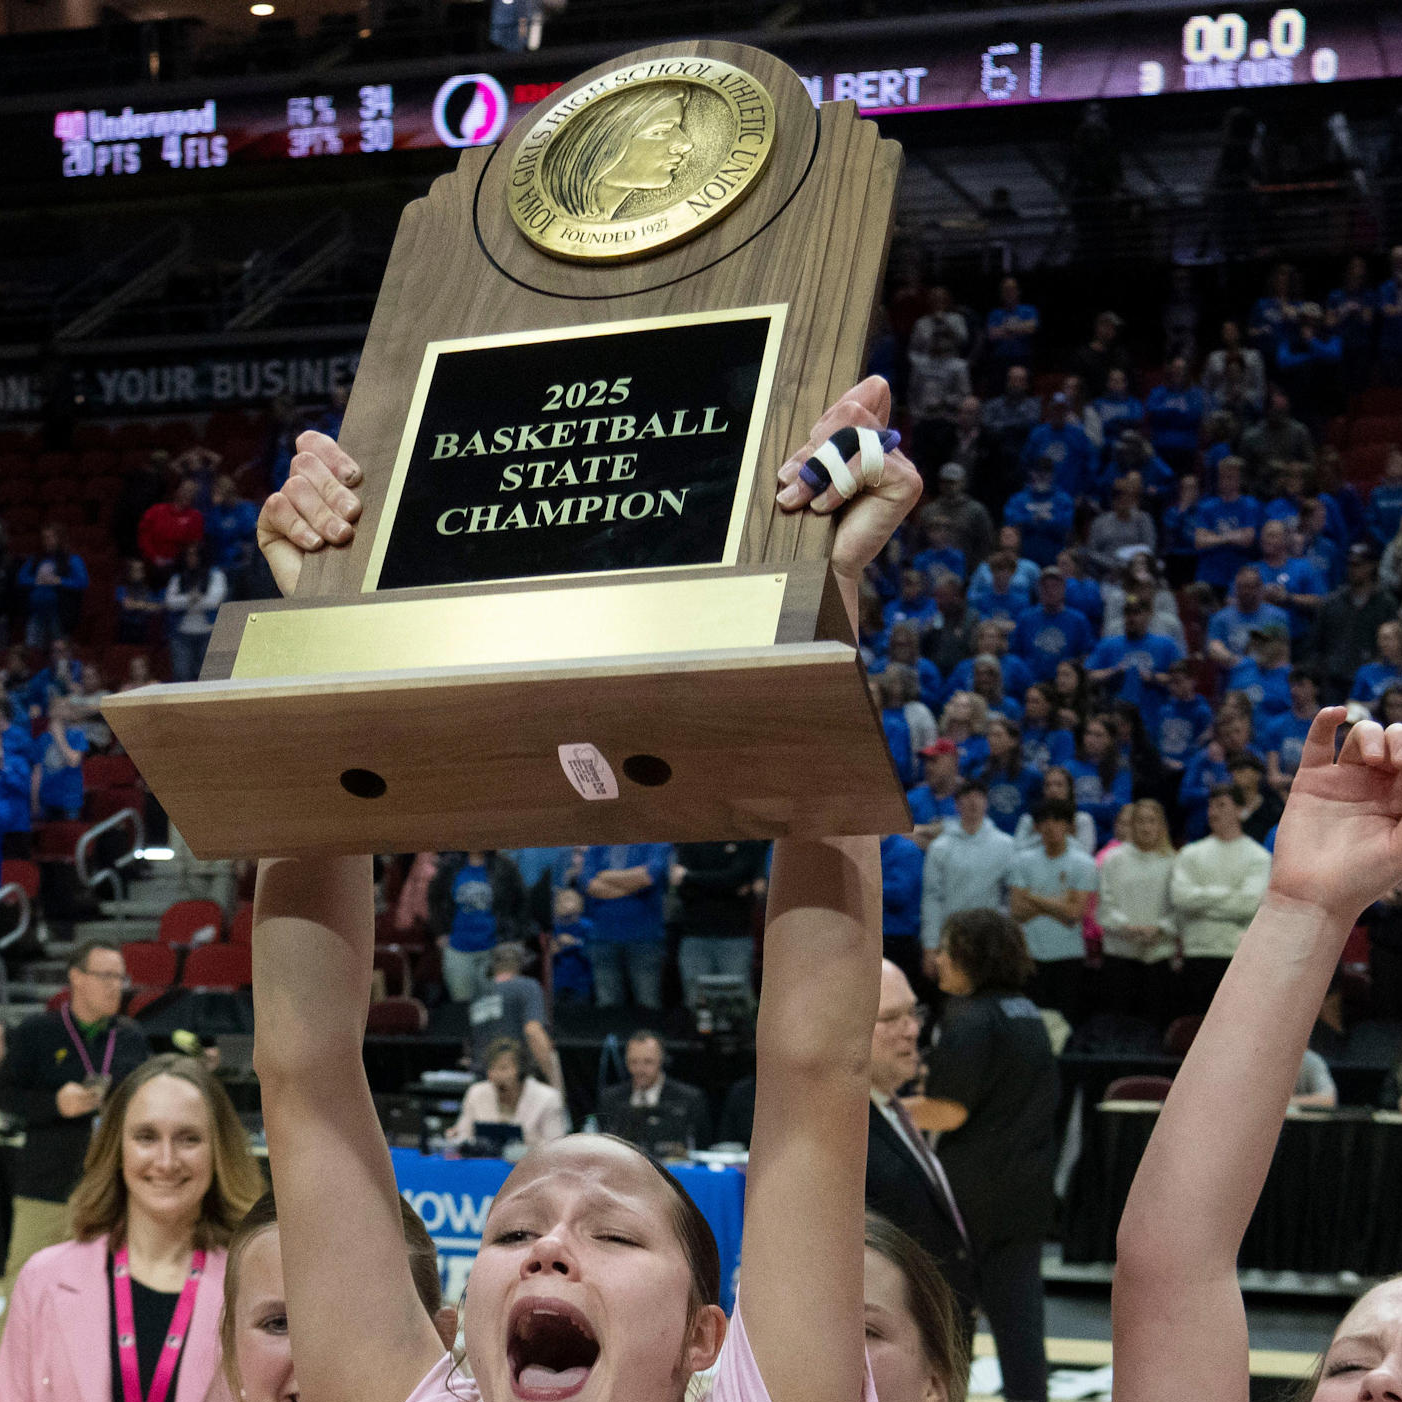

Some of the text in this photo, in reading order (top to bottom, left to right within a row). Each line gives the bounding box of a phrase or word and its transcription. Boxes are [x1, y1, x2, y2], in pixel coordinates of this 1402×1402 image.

[1183, 9, 1306, 64] 00.0
[614, 62, 712, 88] SCHOOL
[800, 68, 929, 108] LBERT
[981, 42, 1042, 101] 61
[88, 100, 216, 143] Underwood
[547, 80, 608, 127] HIGH
[711, 72, 766, 145] ATHLETIC
[94, 143, 140, 176] PTS
[183, 135, 228, 168] FLS
[513, 130, 551, 187] GIRLS
[686, 150, 759, 218] UNION
[516, 191, 557, 236] IOWA
[561, 218, 670, 245] FOUNDED 1927
[97, 364, 196, 405] YOUR
[540, 376, 633, 412] 2025
[429, 406, 730, 461] BASKETBALL
[498, 452, 639, 493] STATE
[435, 487, 691, 536] CHAMPION
